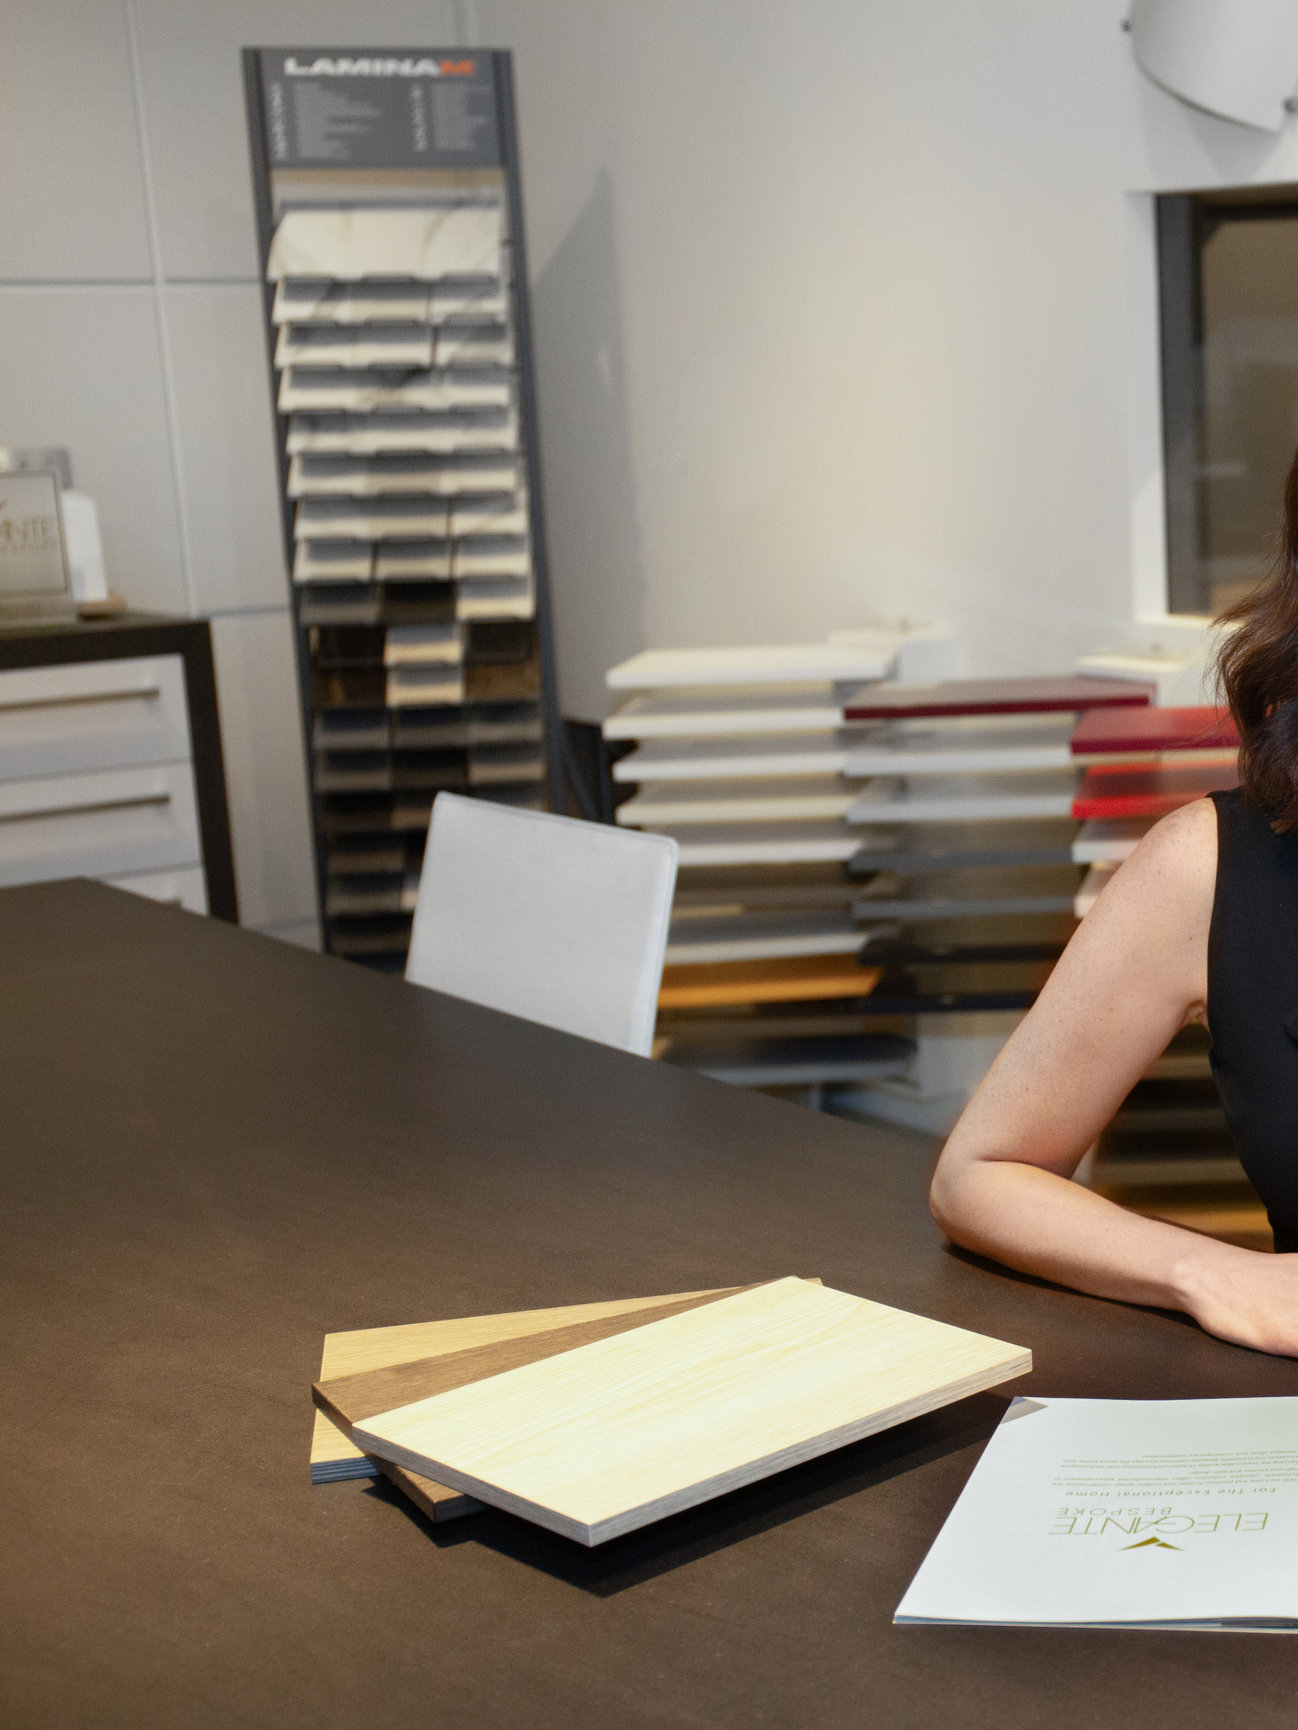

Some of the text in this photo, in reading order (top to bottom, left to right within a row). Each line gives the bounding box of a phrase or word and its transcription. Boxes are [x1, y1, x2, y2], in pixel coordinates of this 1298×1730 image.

[1065, 1490, 1110, 1498] Home
[1117, 1488, 1210, 1497] Exceptional
[1055, 1507, 1173, 1517] BESPOKE
[1048, 1512, 1269, 1535] ELEGANTE
